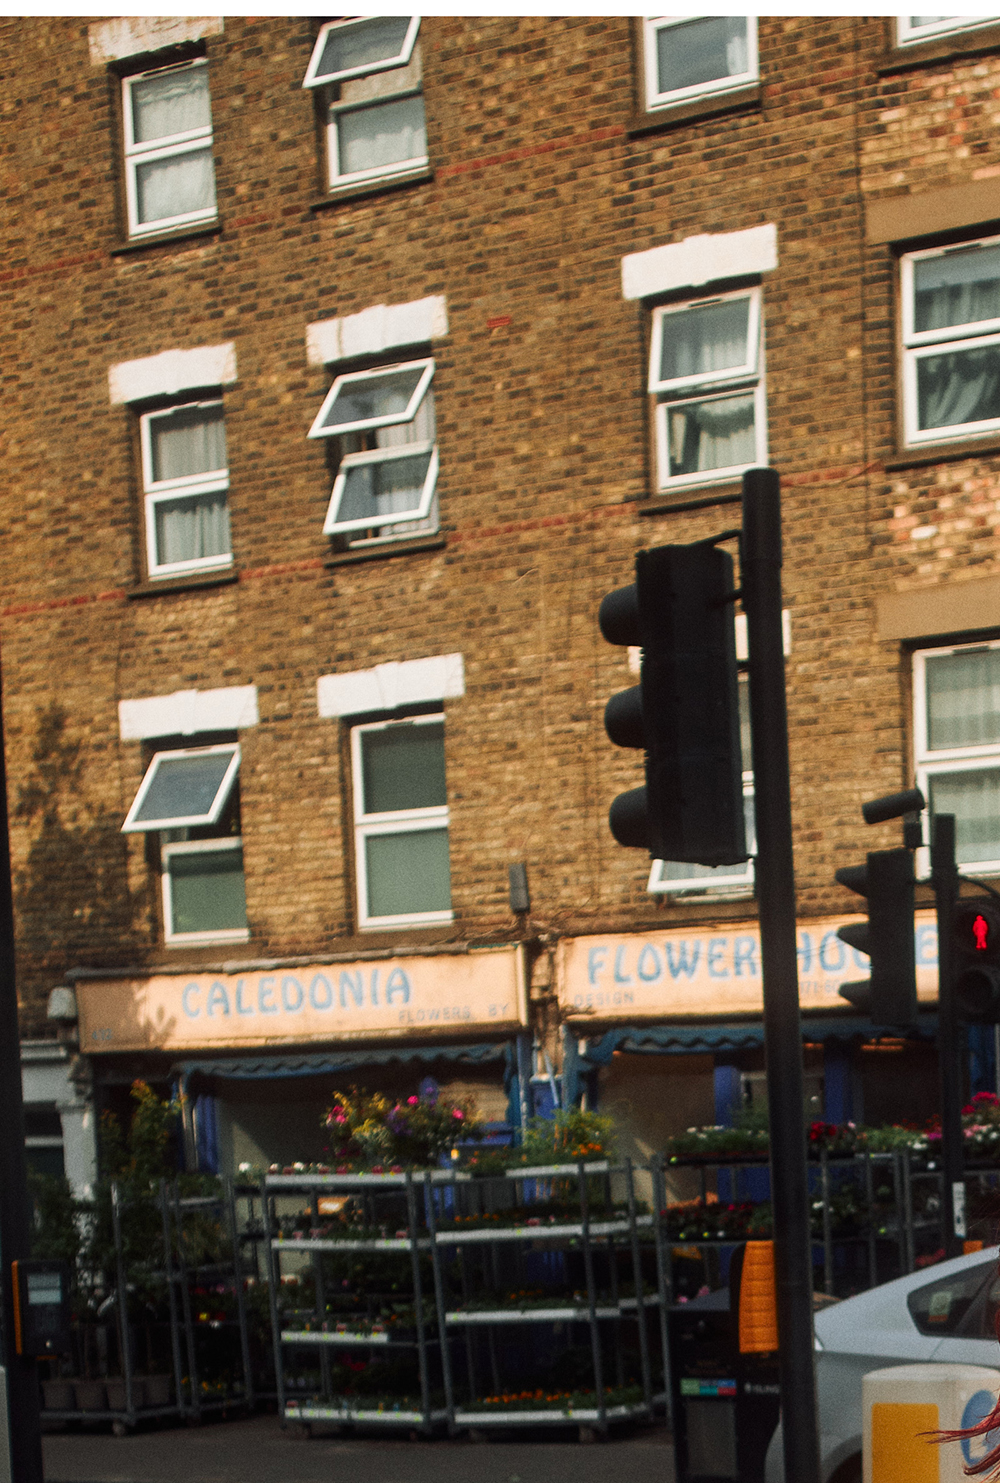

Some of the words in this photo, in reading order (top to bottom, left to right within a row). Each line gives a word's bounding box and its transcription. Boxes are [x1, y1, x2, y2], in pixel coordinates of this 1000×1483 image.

[587, 935, 757, 985] FLOWER
[181, 966, 411, 1018] CALEDONIA
[574, 991, 634, 1008] DESIGN
[398, 1006, 471, 1023] FLOWERS
[488, 1003, 509, 1018] BY
